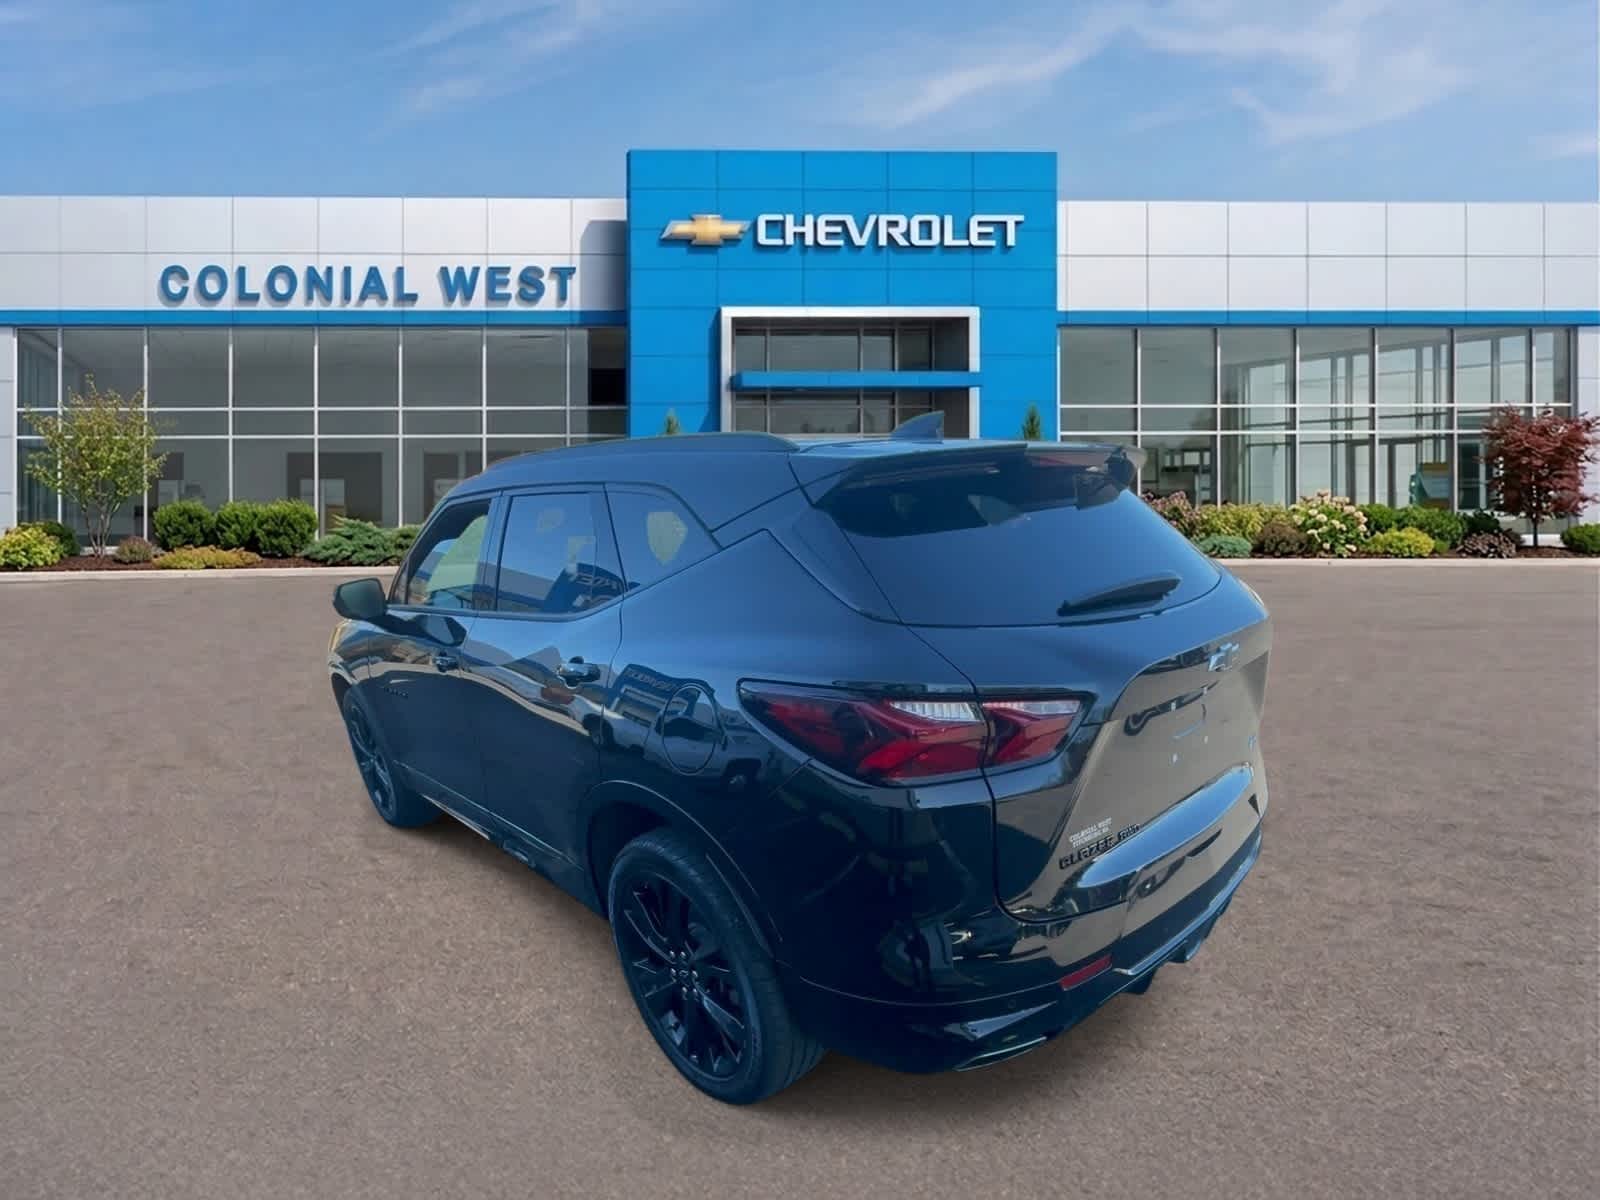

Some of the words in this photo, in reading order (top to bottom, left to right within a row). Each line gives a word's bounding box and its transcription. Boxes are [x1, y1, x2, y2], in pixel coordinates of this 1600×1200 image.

[756, 213, 1025, 248] CHEVROLET
[160, 264, 419, 305] COLONIAL
[439, 264, 577, 305] WEST
